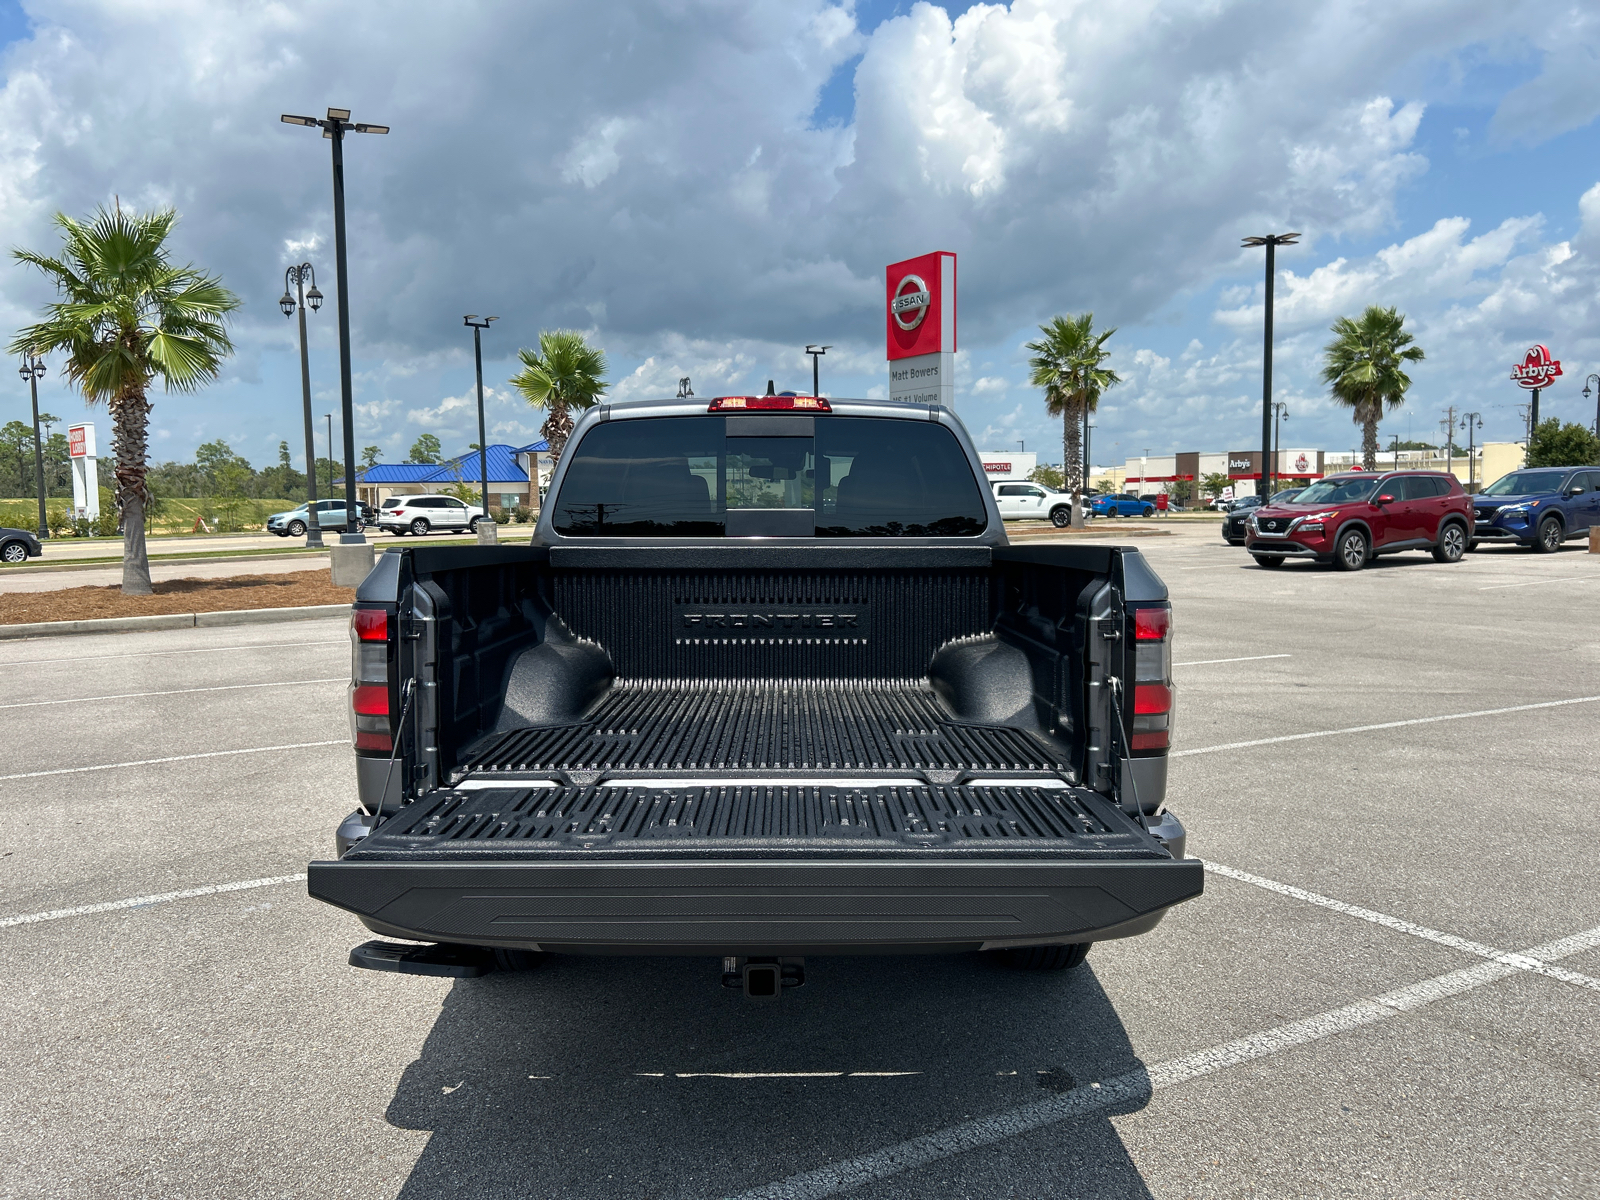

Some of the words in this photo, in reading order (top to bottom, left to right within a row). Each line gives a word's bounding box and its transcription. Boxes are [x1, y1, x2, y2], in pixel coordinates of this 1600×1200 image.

[892, 294, 924, 310] NISSAN
[891, 370, 909, 382] Matt
[910, 366, 939, 379] Bowers
[1510, 360, 1556, 380] Arby's
[913, 392, 938, 403] Volume
[70, 431, 84, 442] HOBBY
[72, 442, 86, 453] LOBBY
[1229, 459, 1250, 470] Arby's
[683, 613, 860, 629] FRONTIER
